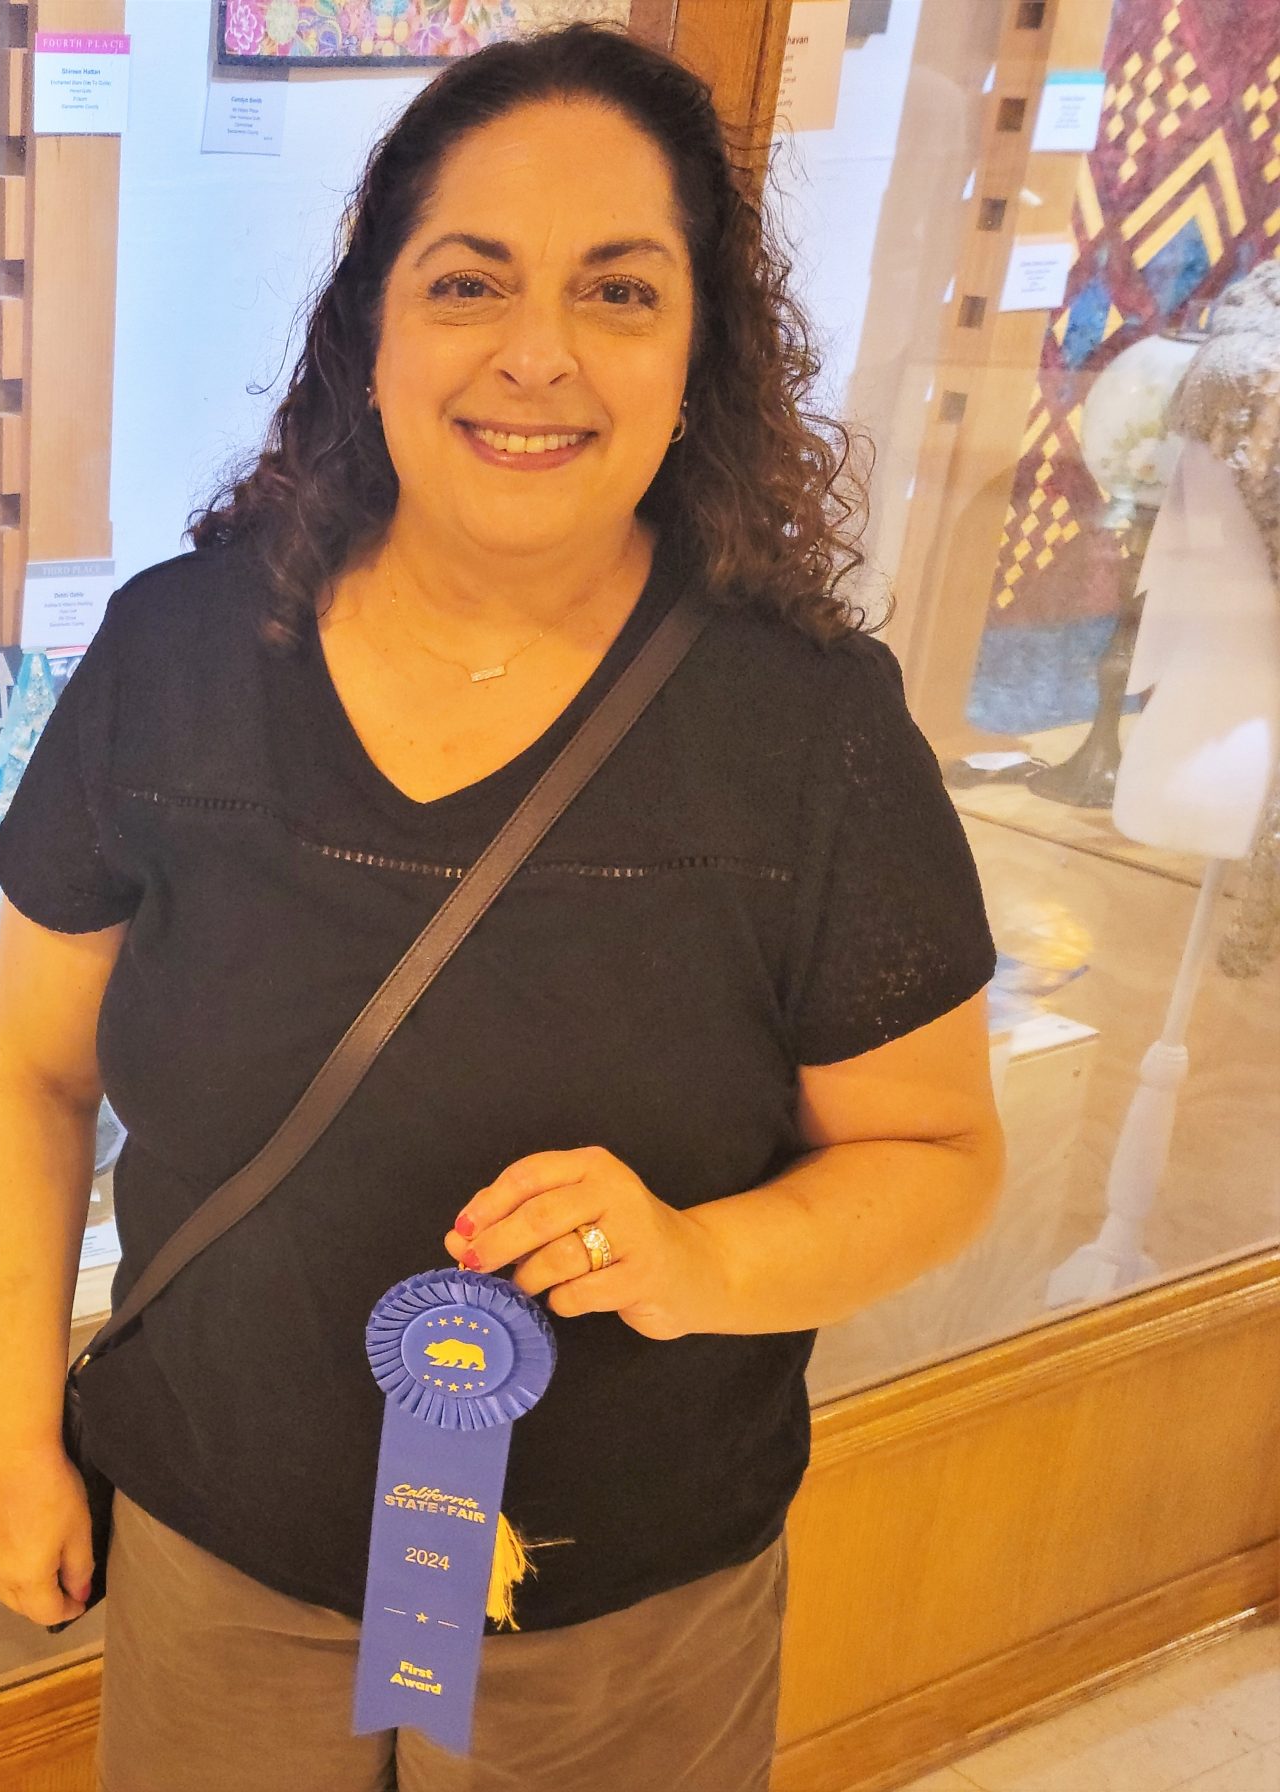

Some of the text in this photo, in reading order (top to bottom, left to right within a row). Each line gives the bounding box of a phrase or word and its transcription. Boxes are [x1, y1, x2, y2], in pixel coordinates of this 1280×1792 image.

[42, 38, 124, 49] FOURTH PLACE
[392, 1483, 479, 1509] California
[384, 1495, 486, 1524] STATE FAIR
[405, 1547, 450, 1571] 2024
[400, 1660, 433, 1680] First
[390, 1672, 442, 1696] Award
